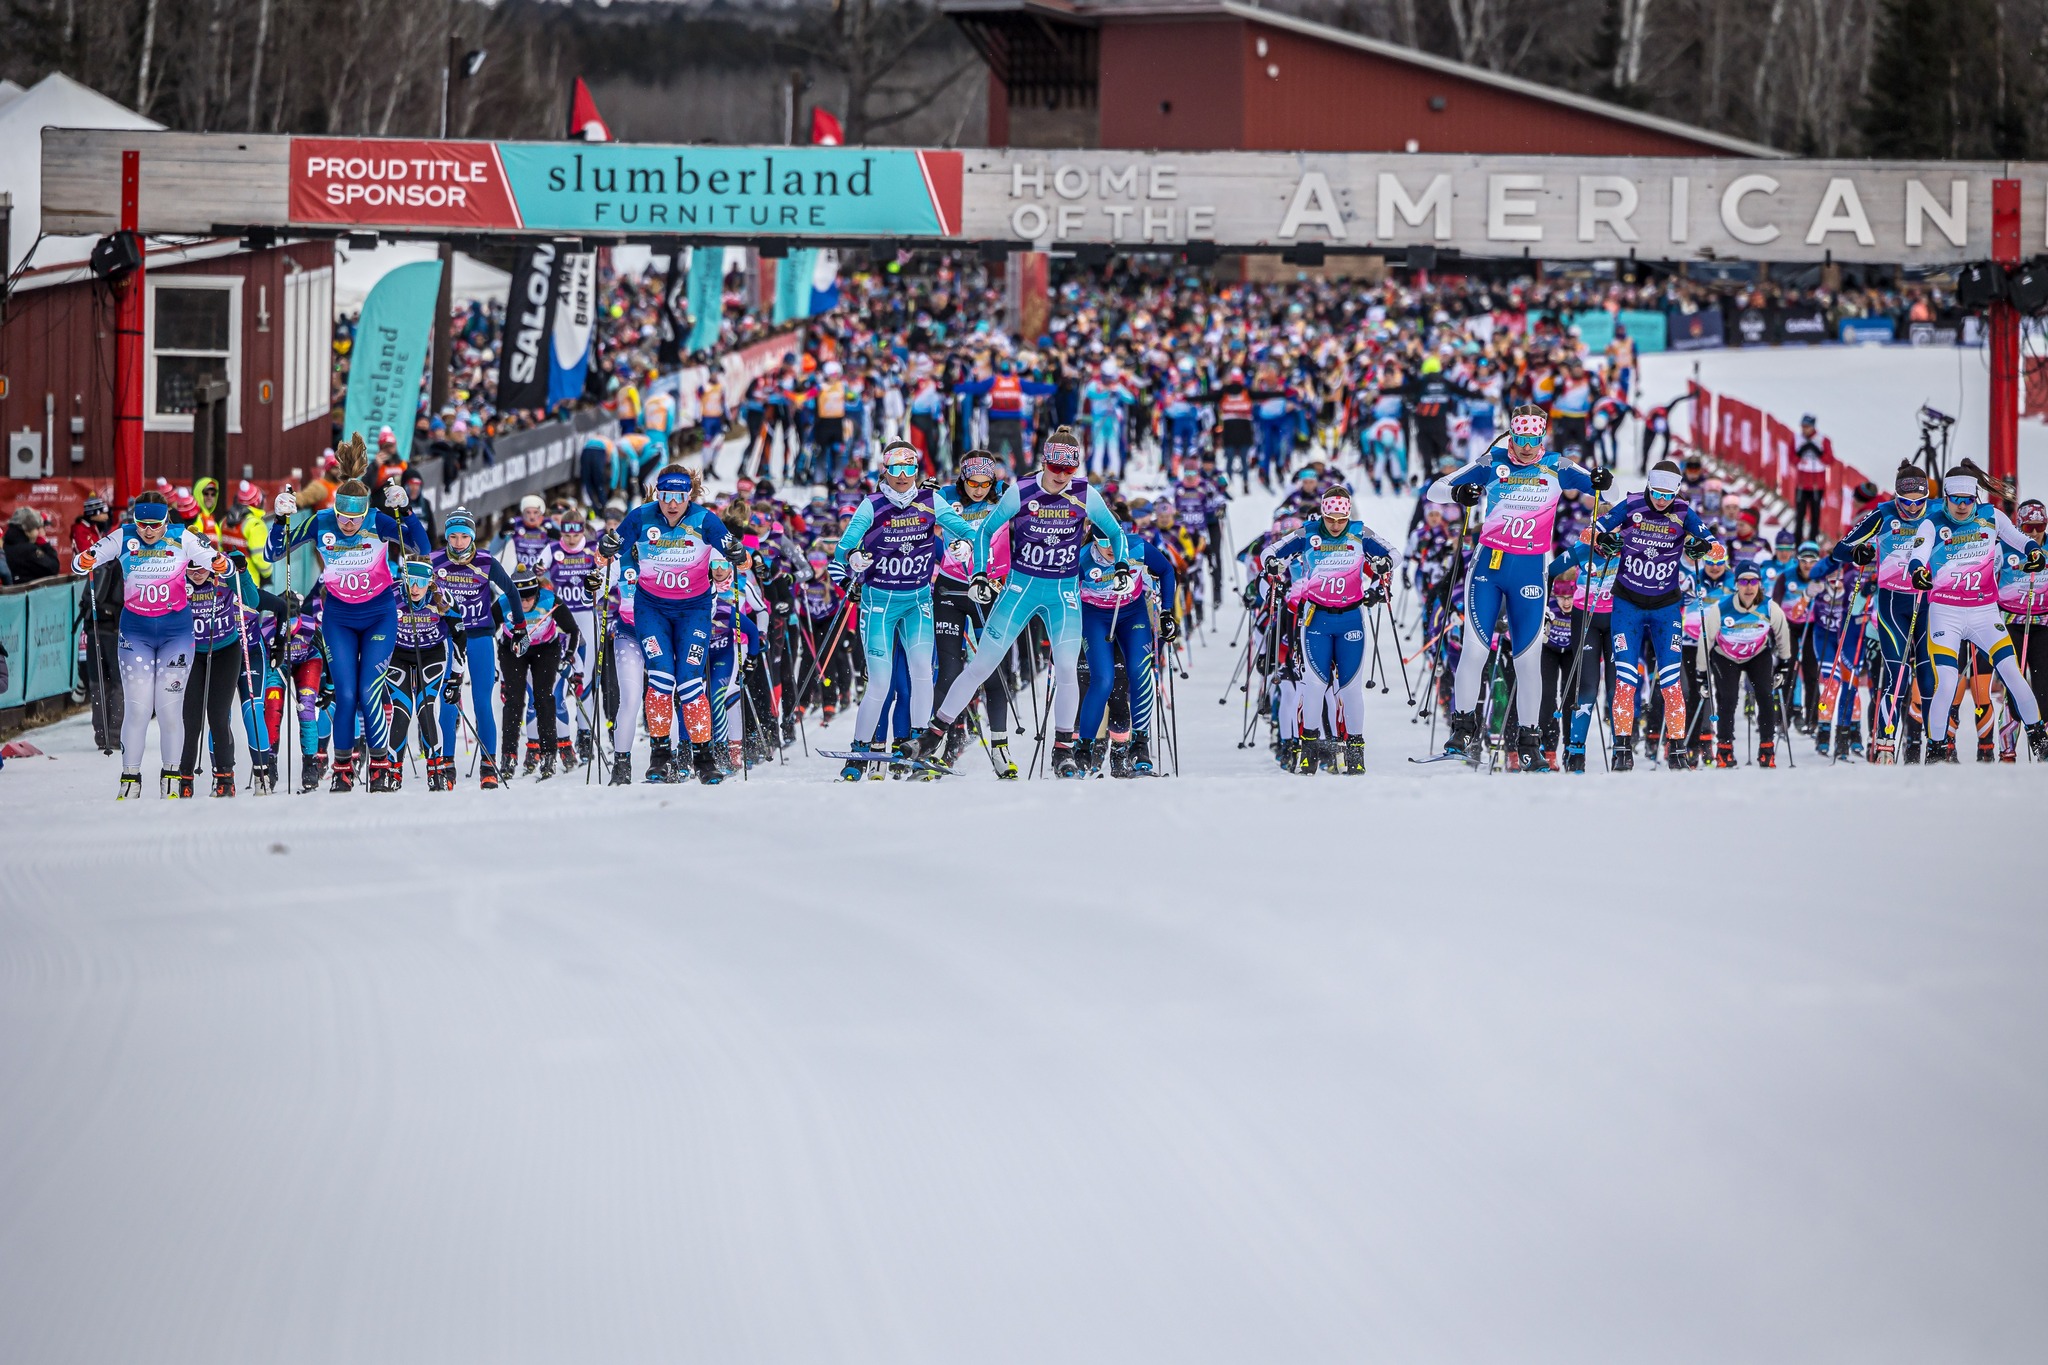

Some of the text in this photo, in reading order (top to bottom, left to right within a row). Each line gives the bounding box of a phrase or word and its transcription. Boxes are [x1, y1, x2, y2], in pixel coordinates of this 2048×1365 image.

[307, 158, 488, 182] PROUD TITLE
[548, 155, 874, 197] slumberland
[1012, 162, 1179, 200] HOME
[326, 184, 466, 208] SPONSOR
[595, 204, 826, 227] FURNITURE
[1277, 174, 1968, 248] AMERICAN
[1011, 204, 1216, 240] OF THE
[1508, 478, 1540, 486] BIRKIE
[1499, 493, 1547, 502] SALOMON
[1038, 509, 1070, 518] BIRKIE
[890, 516, 920, 528] BIRKIE
[1502, 515, 1536, 539] 702
[1640, 522, 1670, 534] BIRKIE
[1030, 526, 1076, 534] SALOMON
[884, 532, 928, 543] SALOMON
[1632, 537, 1674, 548] SALOMON
[1952, 532, 1981, 544] BIRKIE
[656, 540, 686, 548] BIRKIE
[137, 550, 166, 558] BIRKIE
[1946, 549, 1989, 560] SALOMON
[130, 564, 175, 572] SALOMON
[876, 552, 932, 576] 40037
[334, 571, 370, 590] 703
[446, 576, 474, 584] BIRKIE
[653, 566, 690, 588] 706
[1951, 571, 1982, 591] 712
[1318, 575, 1346, 595] 719
[136, 584, 170, 604] 709
[192, 592, 214, 602] BIRKI
[556, 586, 582, 602] 400
[1524, 587, 1540, 596] BNR
[192, 604, 224, 614] ALOMON
[936, 621, 960, 631] MPLS
[1552, 620, 1572, 628] BIRK
